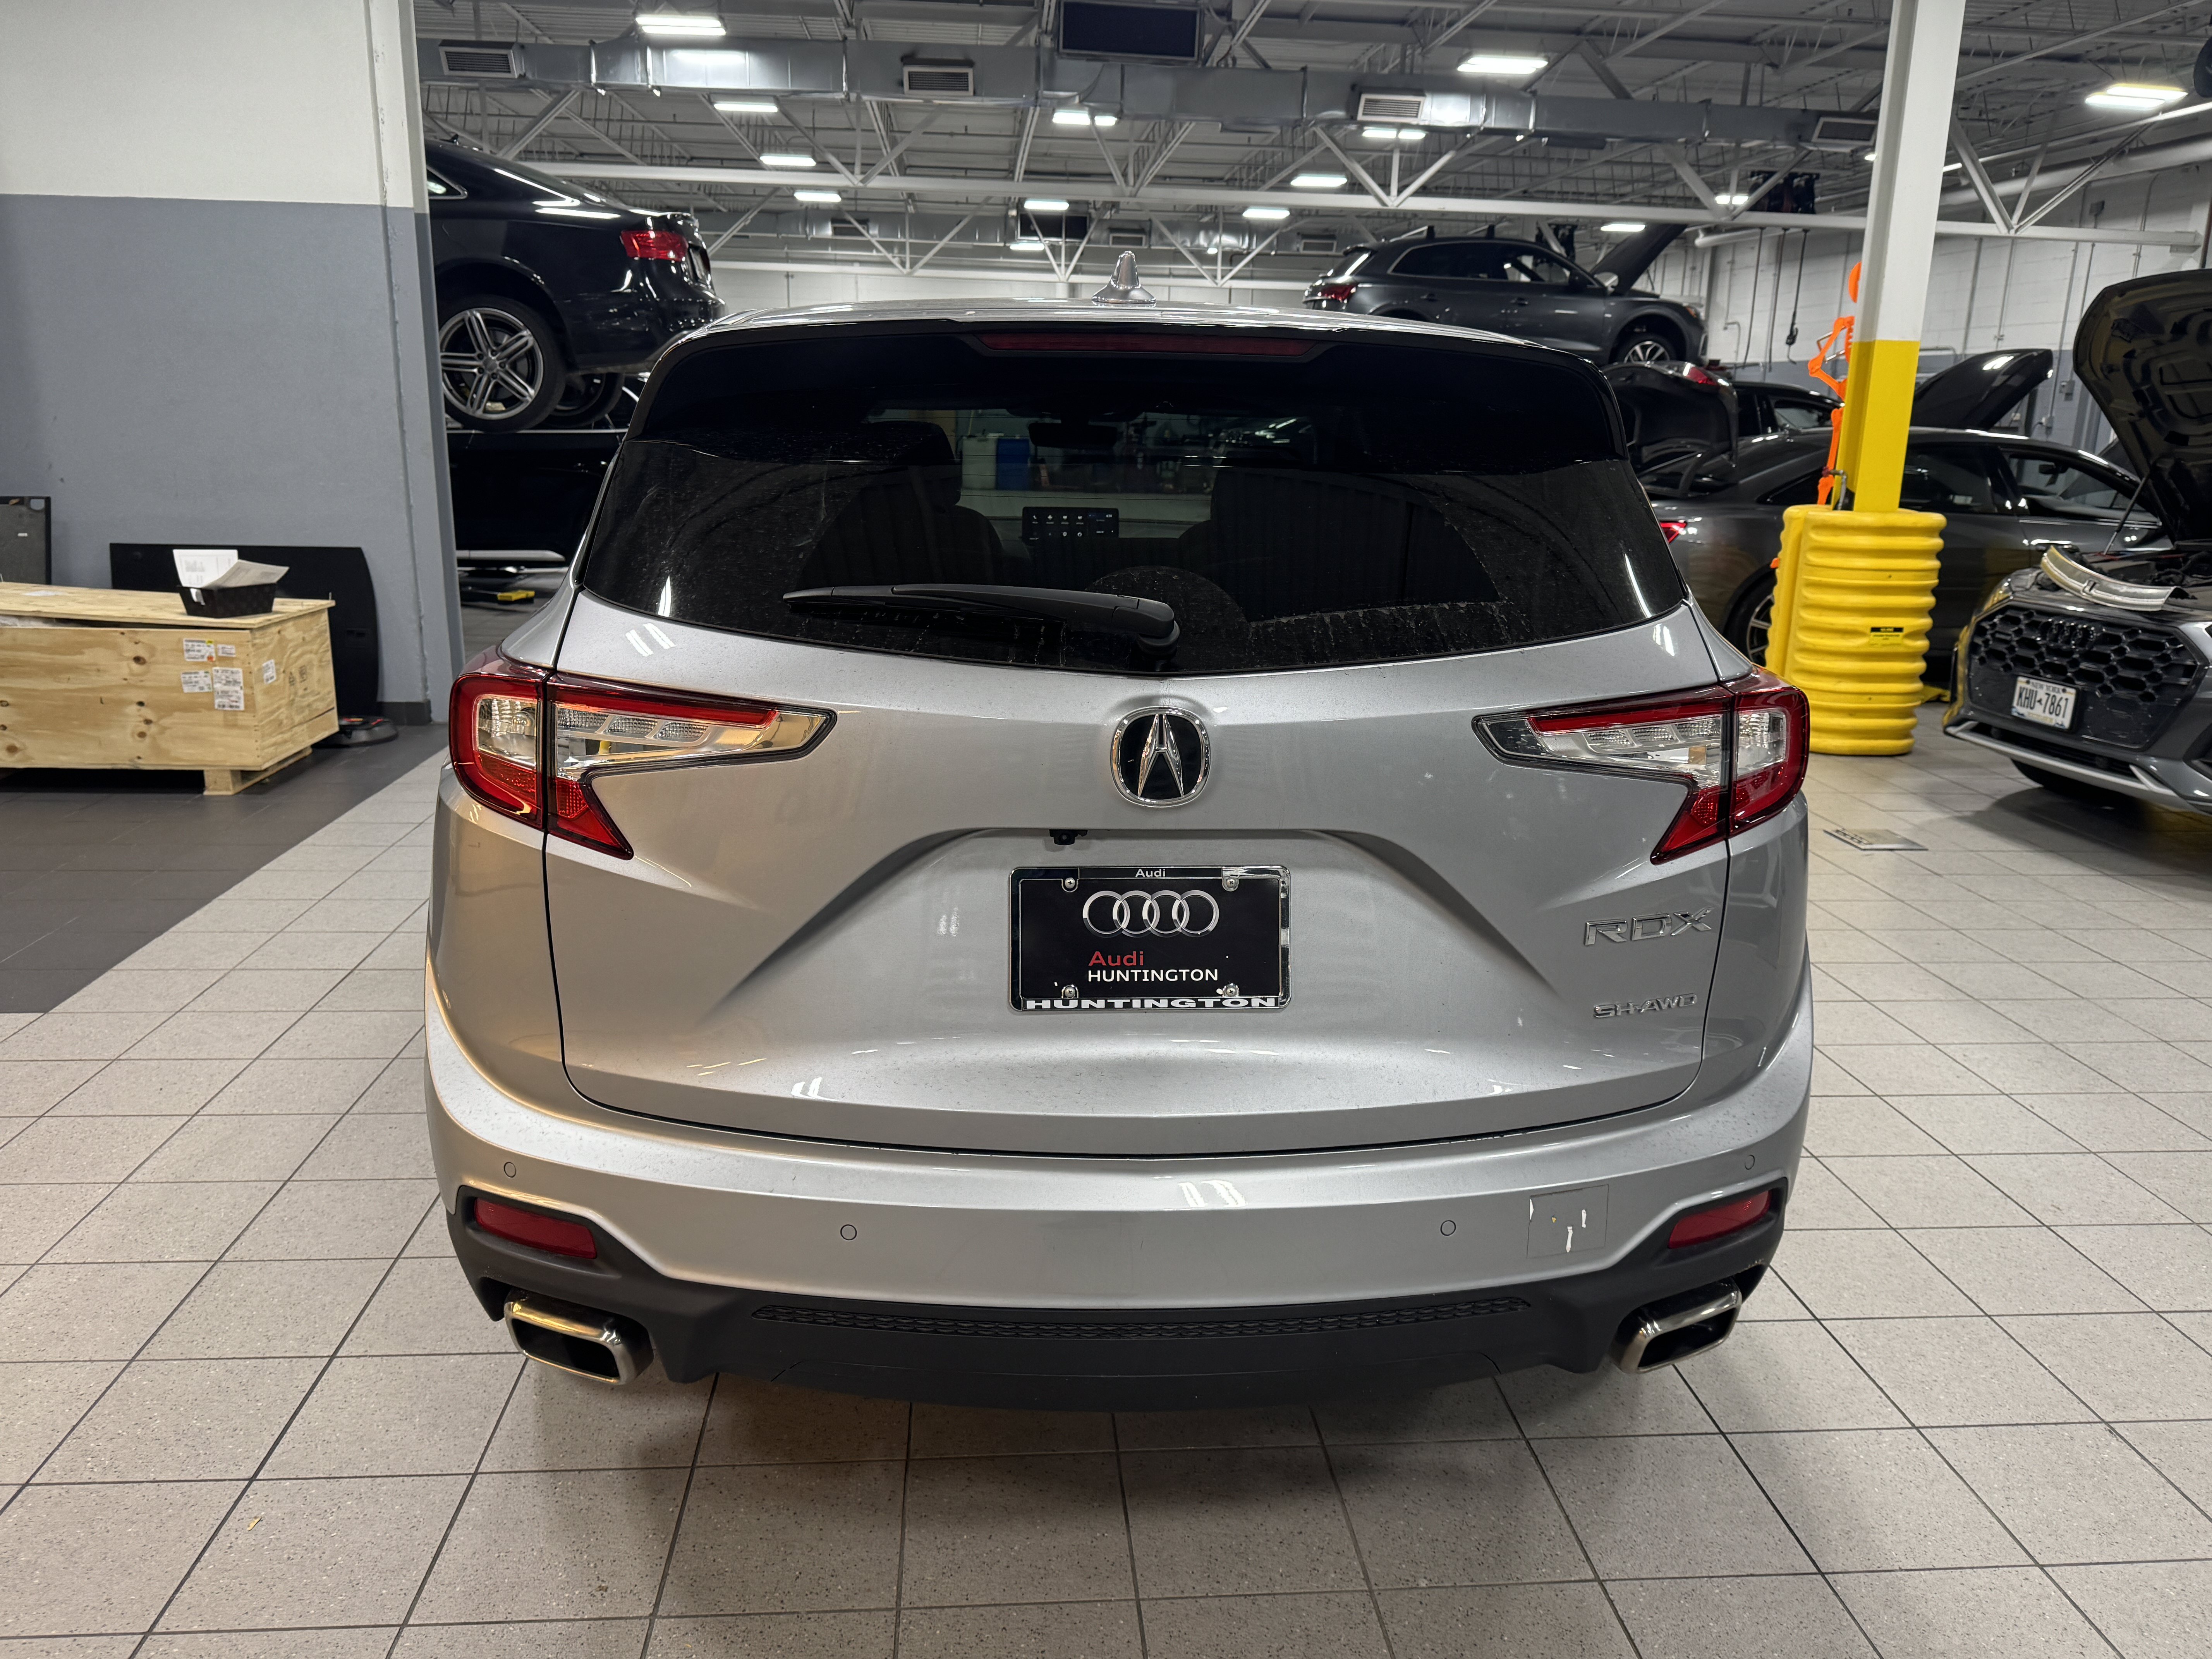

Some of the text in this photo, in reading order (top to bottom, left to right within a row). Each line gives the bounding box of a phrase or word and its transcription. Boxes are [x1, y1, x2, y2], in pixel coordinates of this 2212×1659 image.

[1135, 869, 1166, 878] Audi
[1584, 907, 1713, 945] RDX
[1088, 951, 1144, 967] Audi
[1088, 969, 1218, 982] HUNTINGTON
[1026, 998, 1276, 1009] HUNTINGTON
[1593, 993, 1698, 1018] SH-AWD
